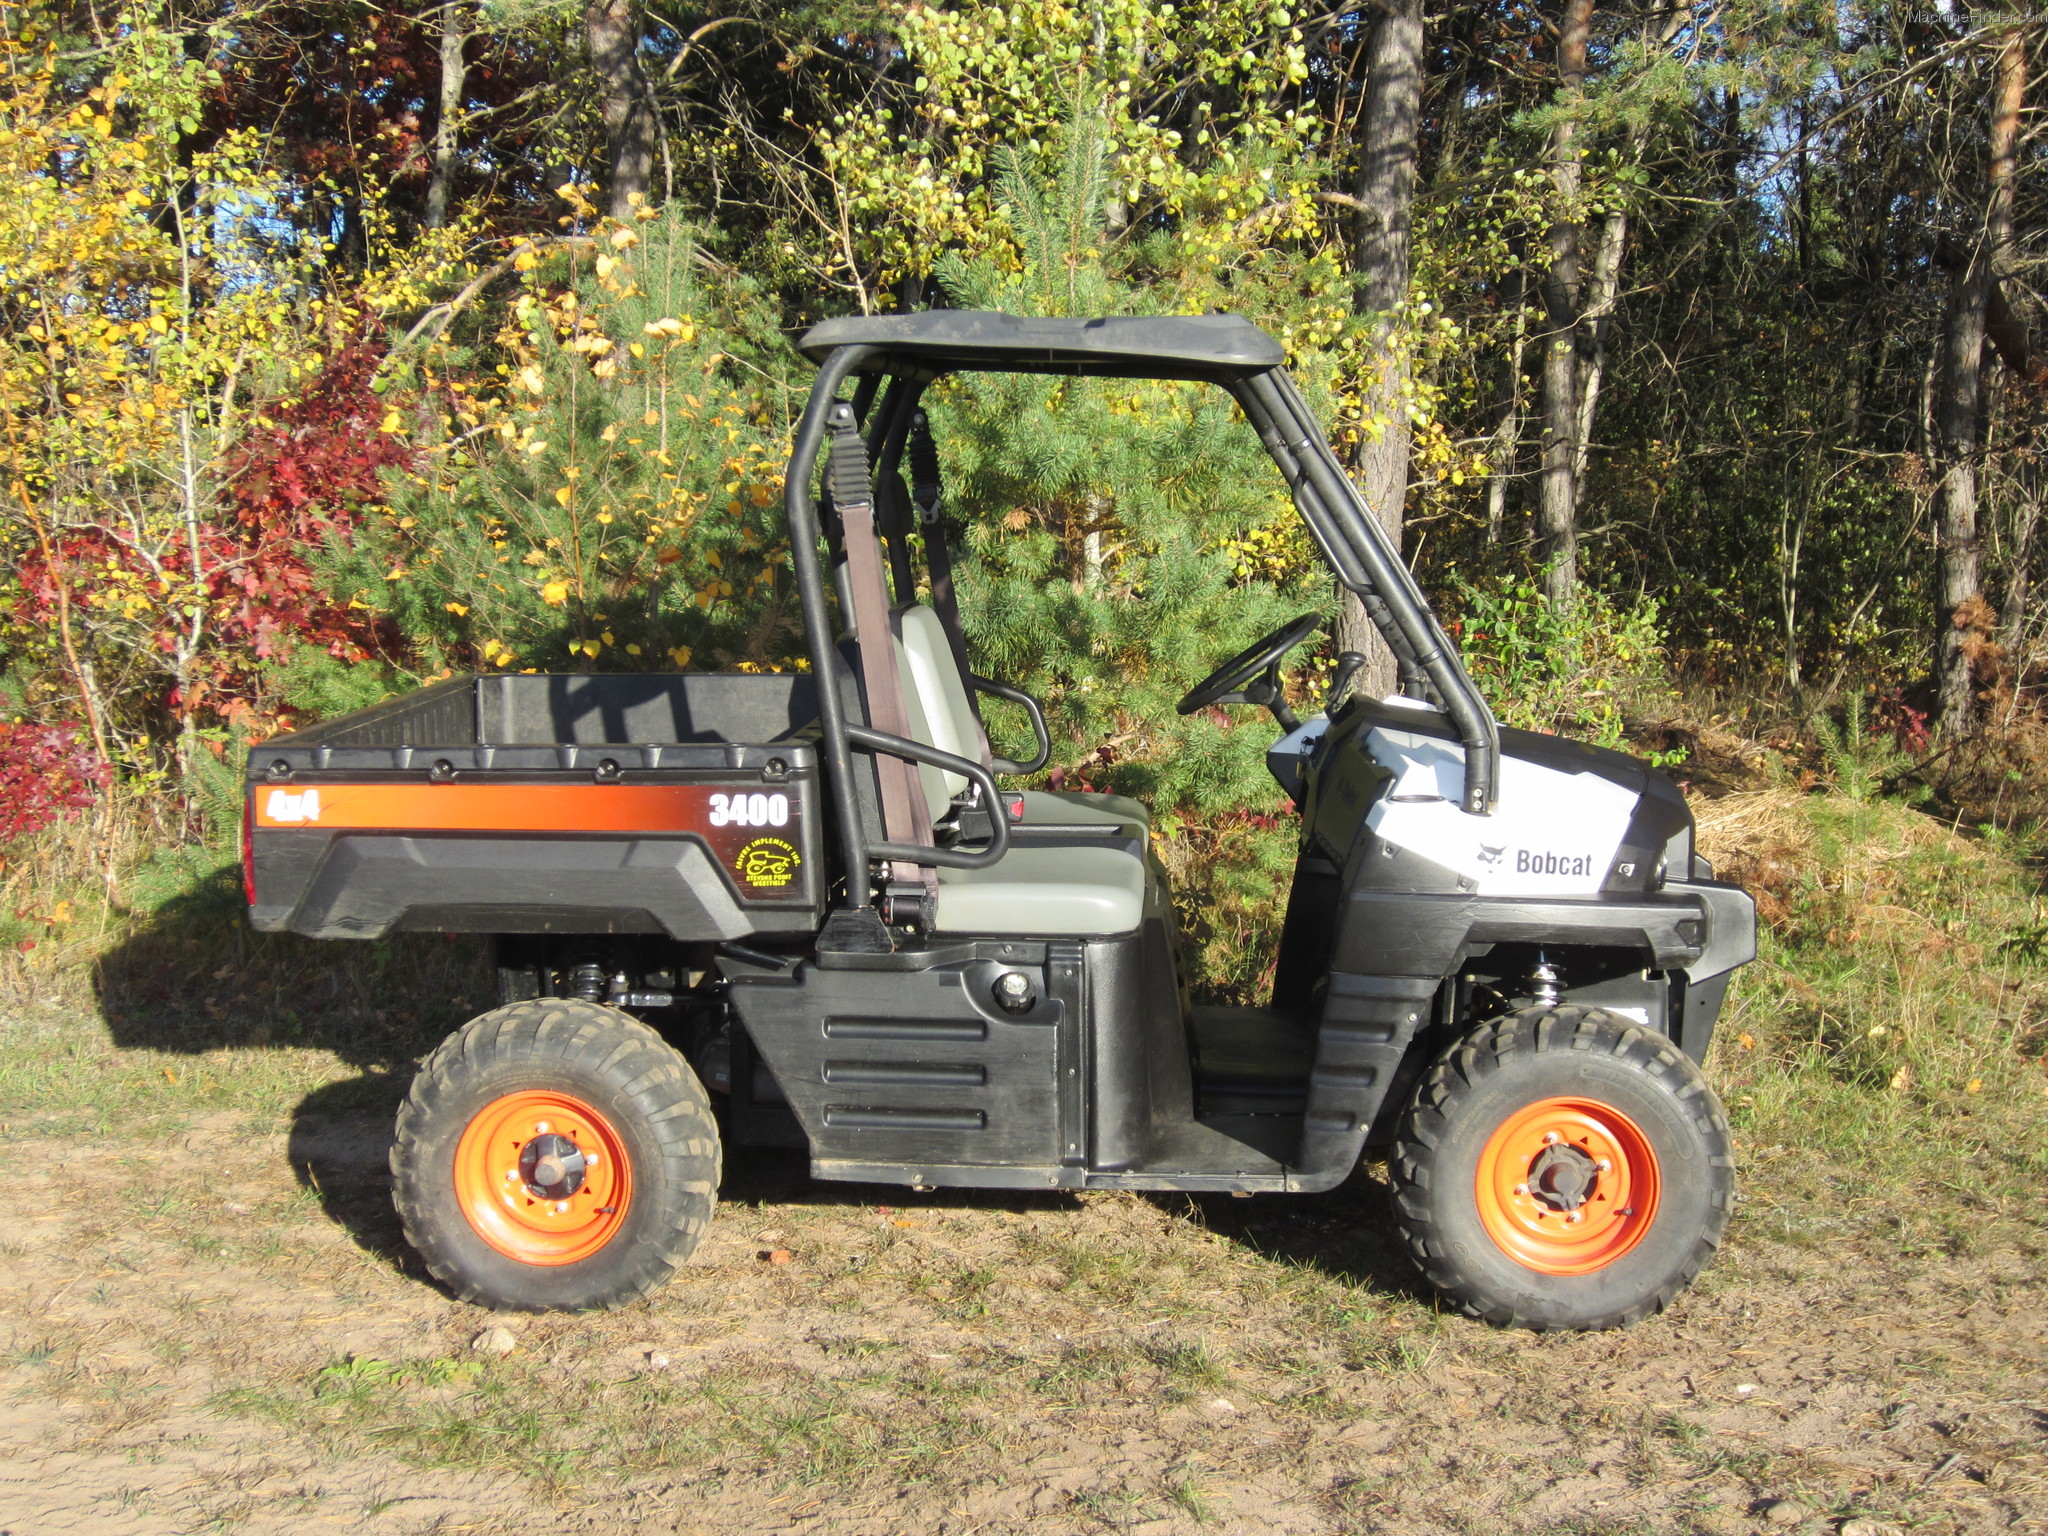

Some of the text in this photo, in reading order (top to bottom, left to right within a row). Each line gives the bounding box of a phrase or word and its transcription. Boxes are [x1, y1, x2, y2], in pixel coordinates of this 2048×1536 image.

[266, 788, 320, 822] 4x4
[708, 793, 789, 827] 3400
[751, 837, 793, 852] IMPLEMENT
[790, 851, 801, 867] INC.
[1516, 849, 1592, 876] Bobcat
[746, 874, 772, 882] STEVENS
